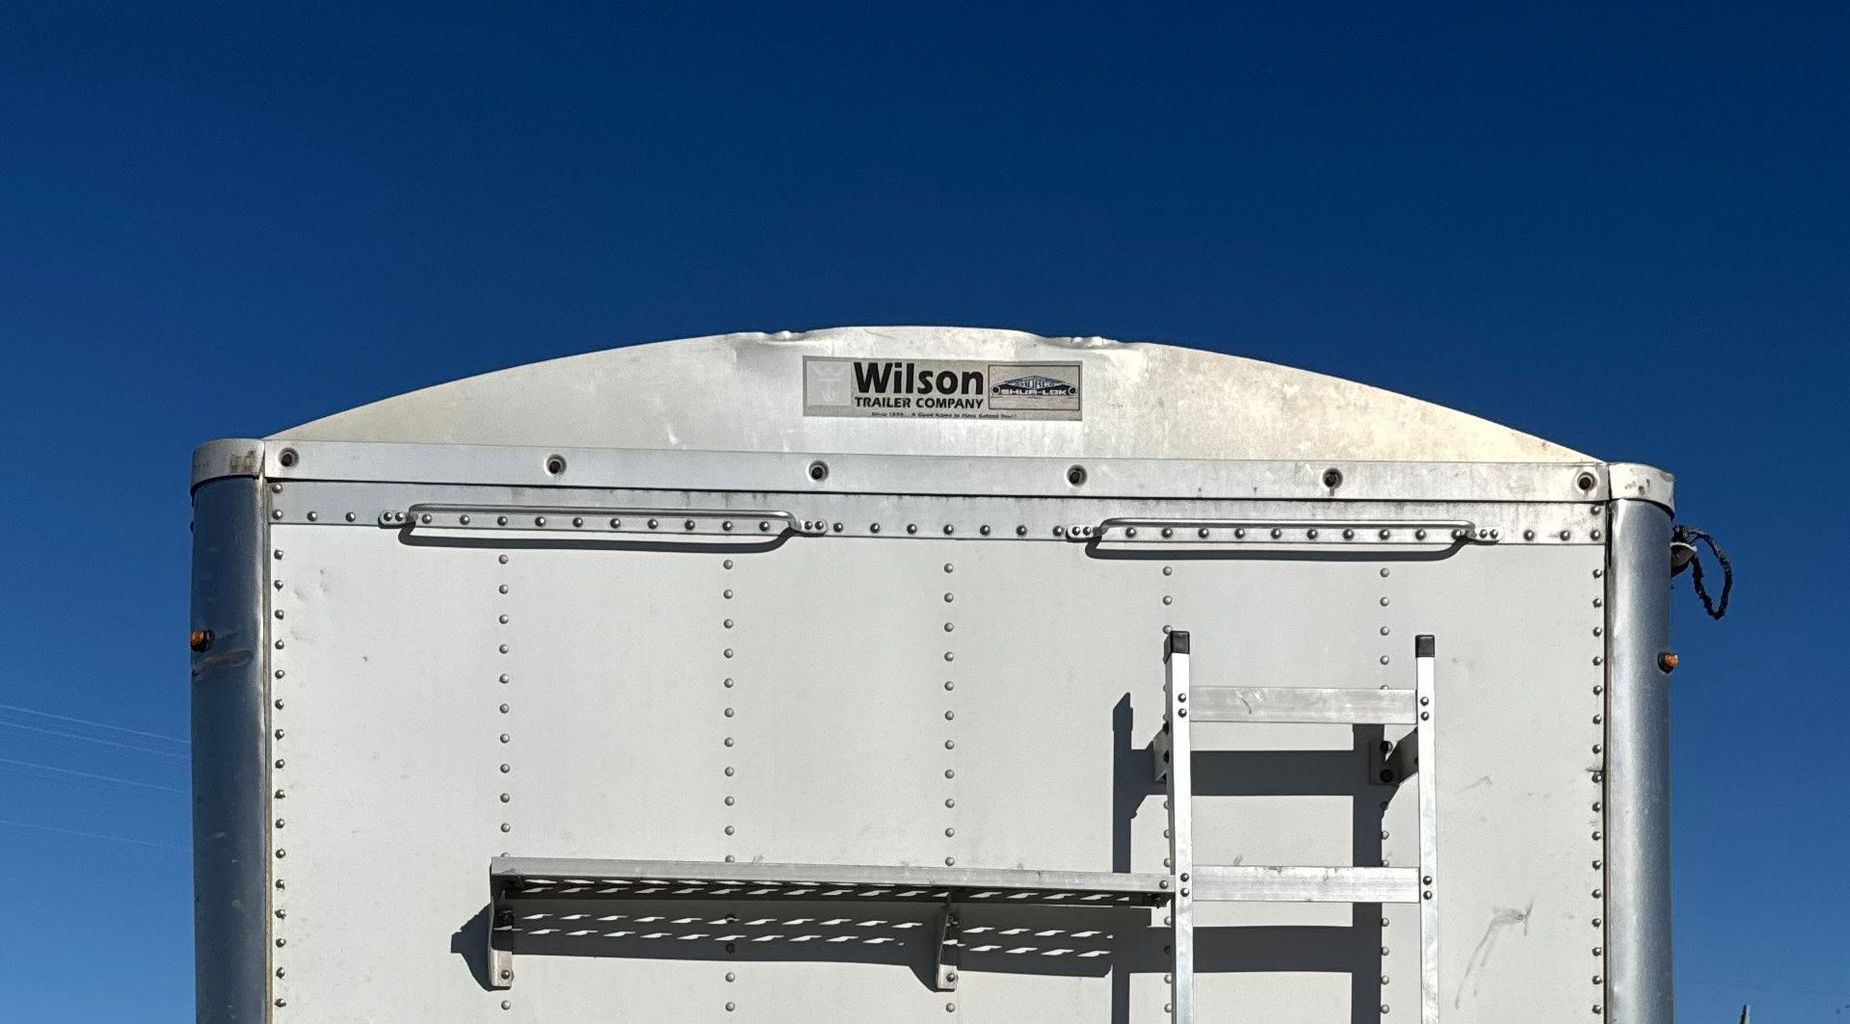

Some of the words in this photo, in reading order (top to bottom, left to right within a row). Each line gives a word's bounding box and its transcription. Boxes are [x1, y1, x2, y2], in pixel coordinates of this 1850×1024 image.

[853, 362, 984, 395] Wilson
[854, 397, 911, 408] TRAILER
[916, 397, 984, 410] COMPANY
